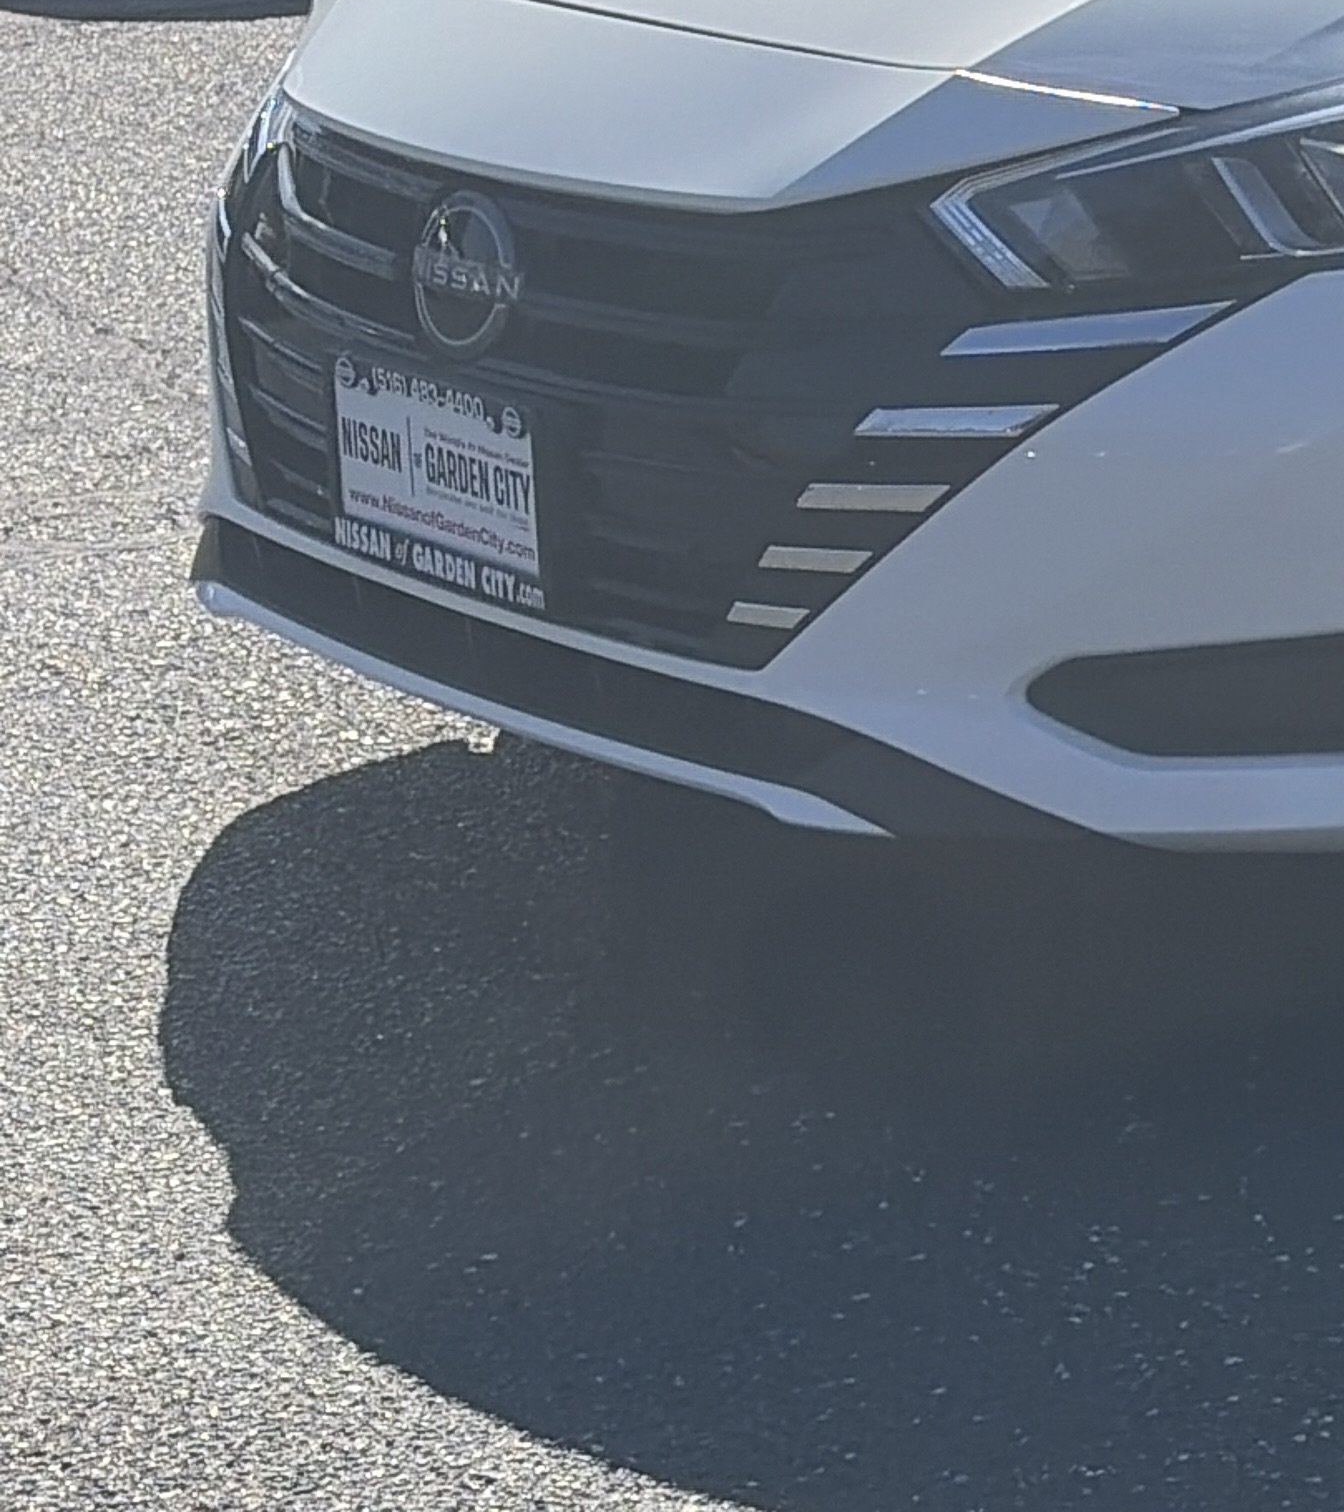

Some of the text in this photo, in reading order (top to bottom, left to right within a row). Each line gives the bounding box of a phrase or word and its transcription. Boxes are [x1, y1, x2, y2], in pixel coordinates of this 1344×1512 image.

[371, 365, 407, 397] (516)
[341, 416, 403, 473] NISSAN
[424, 442, 491, 503] GARDEN
[494, 465, 531, 516] CITY
[347, 488, 536, 561] www.NissanofGardenCity.com
[334, 516, 546, 611] NISSAN of GARDEN CITY.com
